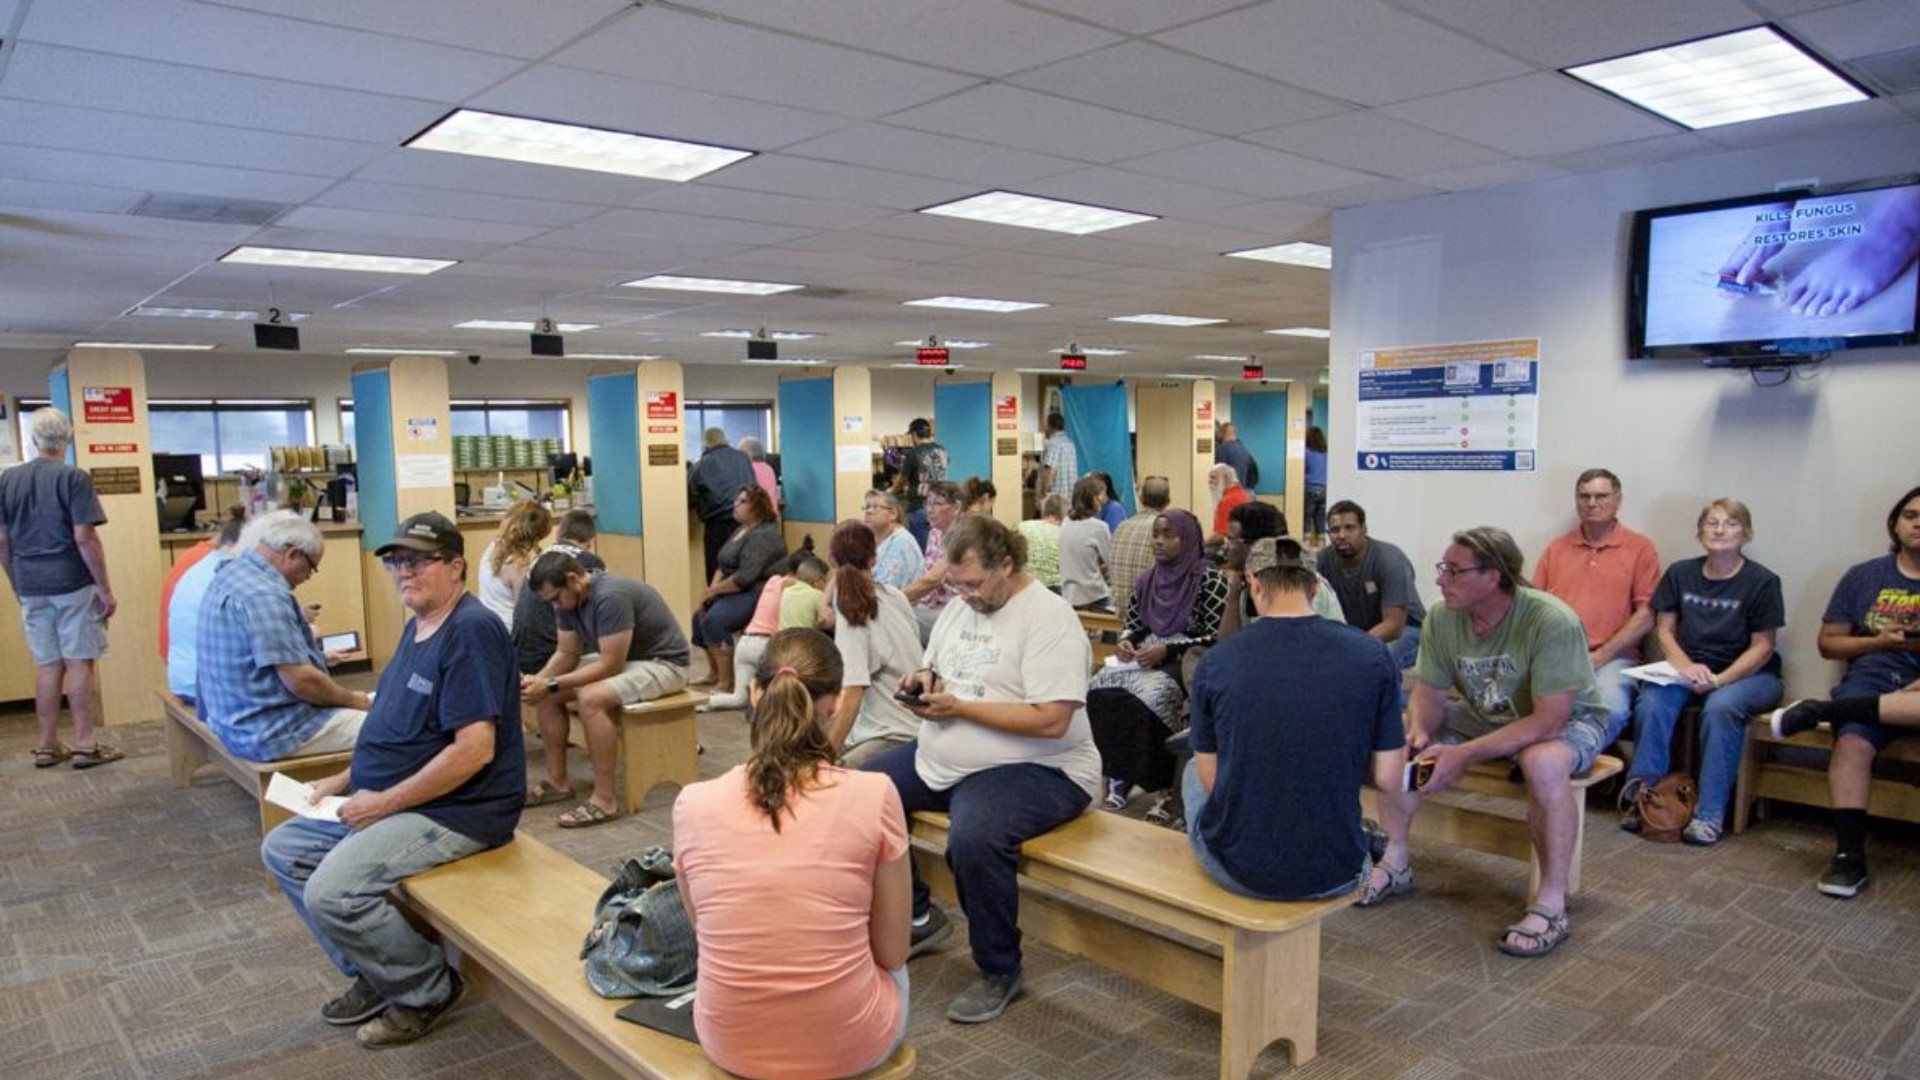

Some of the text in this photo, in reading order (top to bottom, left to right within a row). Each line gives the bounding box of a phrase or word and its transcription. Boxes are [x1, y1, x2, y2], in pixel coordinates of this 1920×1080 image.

[1755, 203, 1854, 223] KILLS FUNGUS
[1754, 225, 1861, 245] RESTORES SKIN
[268, 308, 281, 324] 2
[543, 318, 552, 333] 3
[757, 328, 766, 340] 4
[928, 335, 937, 348] 5
